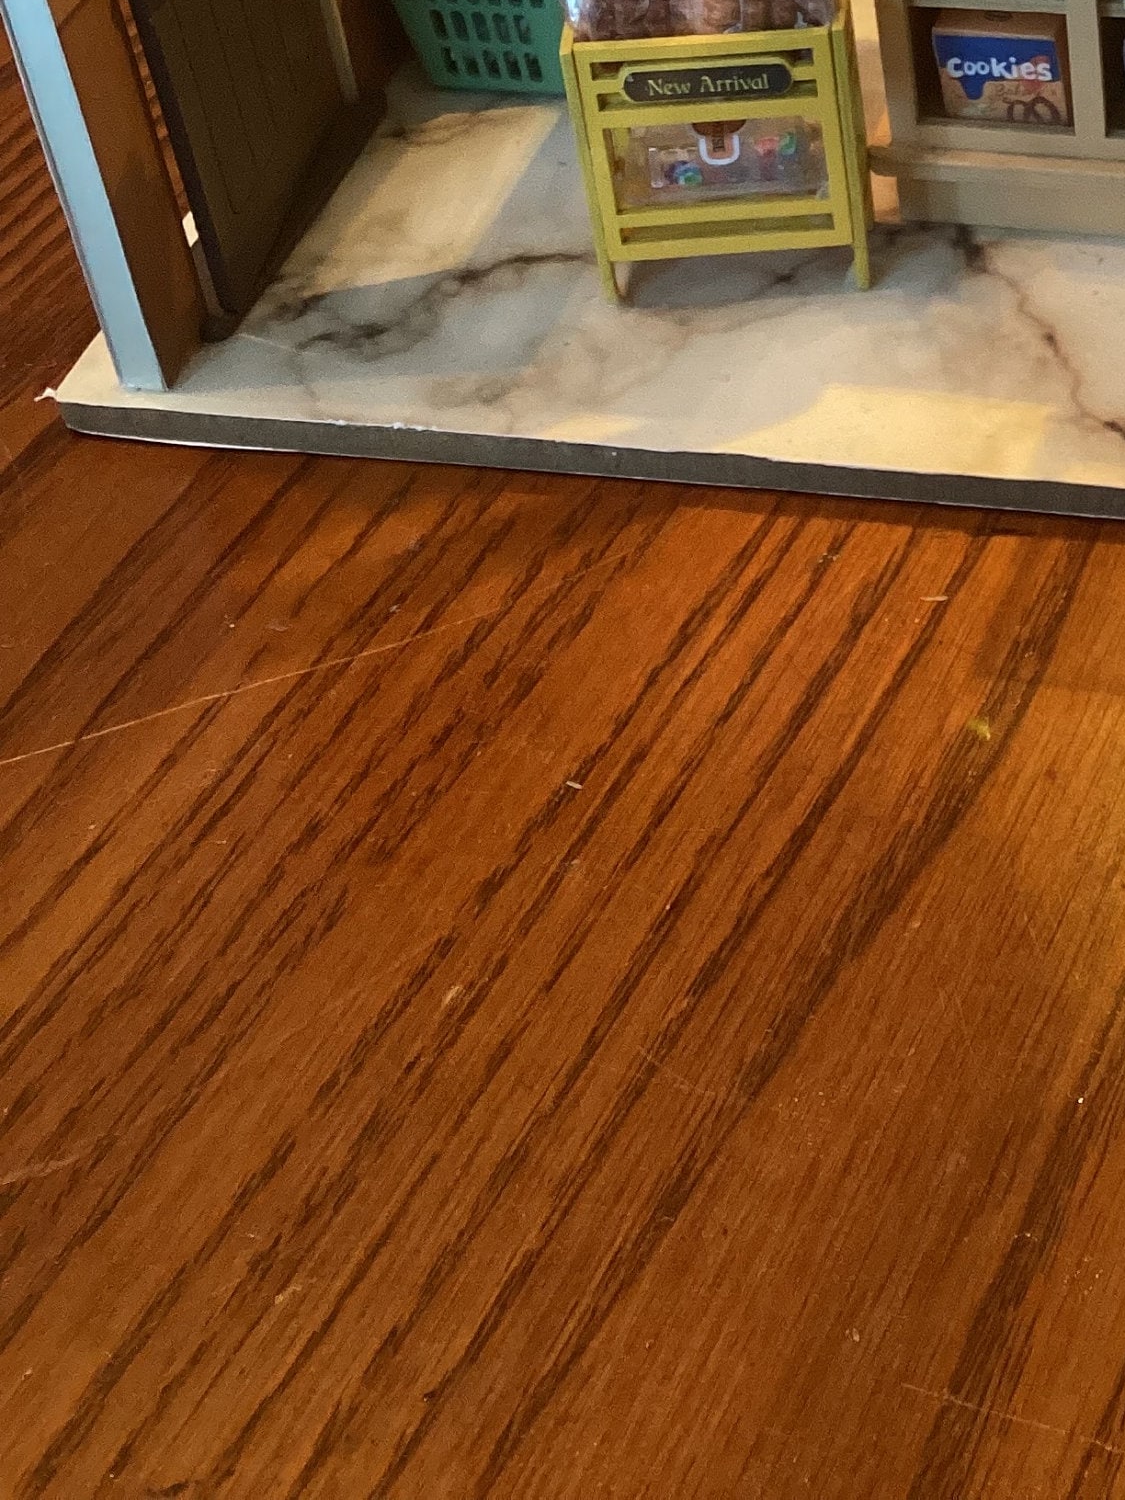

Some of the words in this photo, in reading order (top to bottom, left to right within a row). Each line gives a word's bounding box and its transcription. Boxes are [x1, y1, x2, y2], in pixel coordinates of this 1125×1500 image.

[945, 56, 1053, 82] Cookies
[646, 78, 692, 97] New
[699, 73, 770, 94] Arrival
